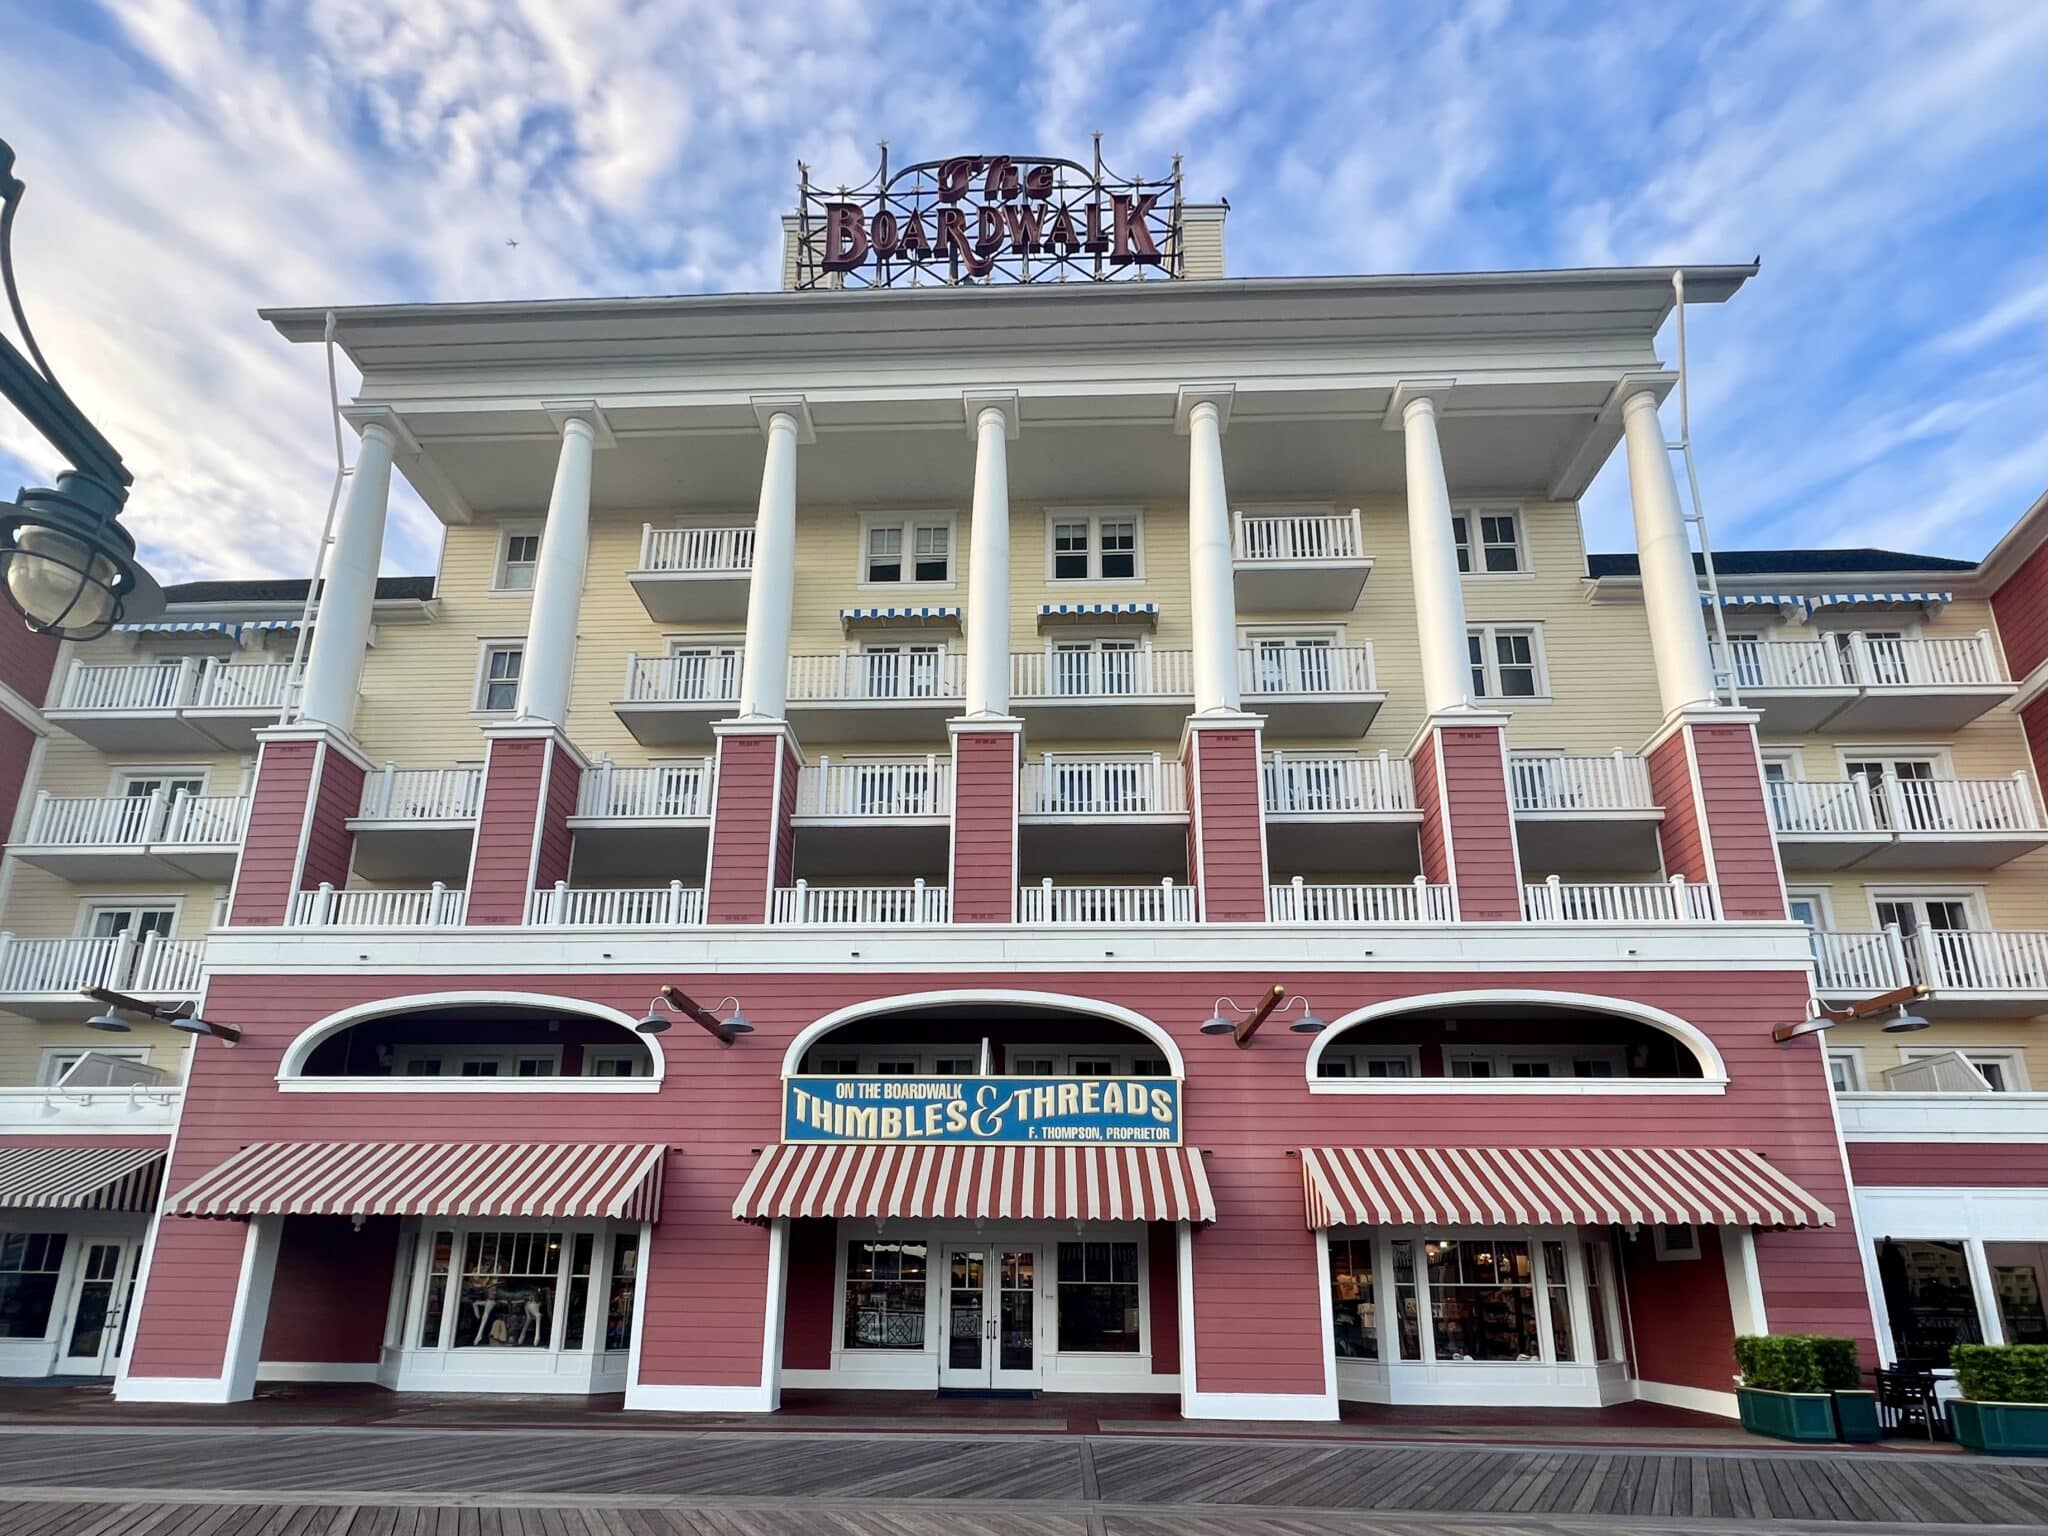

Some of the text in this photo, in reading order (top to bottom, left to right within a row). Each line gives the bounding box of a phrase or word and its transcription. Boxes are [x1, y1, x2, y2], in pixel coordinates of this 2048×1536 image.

[938, 155, 1054, 202] The
[821, 194, 1162, 277] BOARDWALK
[793, 1081, 1173, 1139] THIMBLES & THREADS
[836, 1082, 962, 1100] ON THE BOARDWALK
[1028, 1126, 1171, 1142] F. THOMPSON, PROPRIETOR
